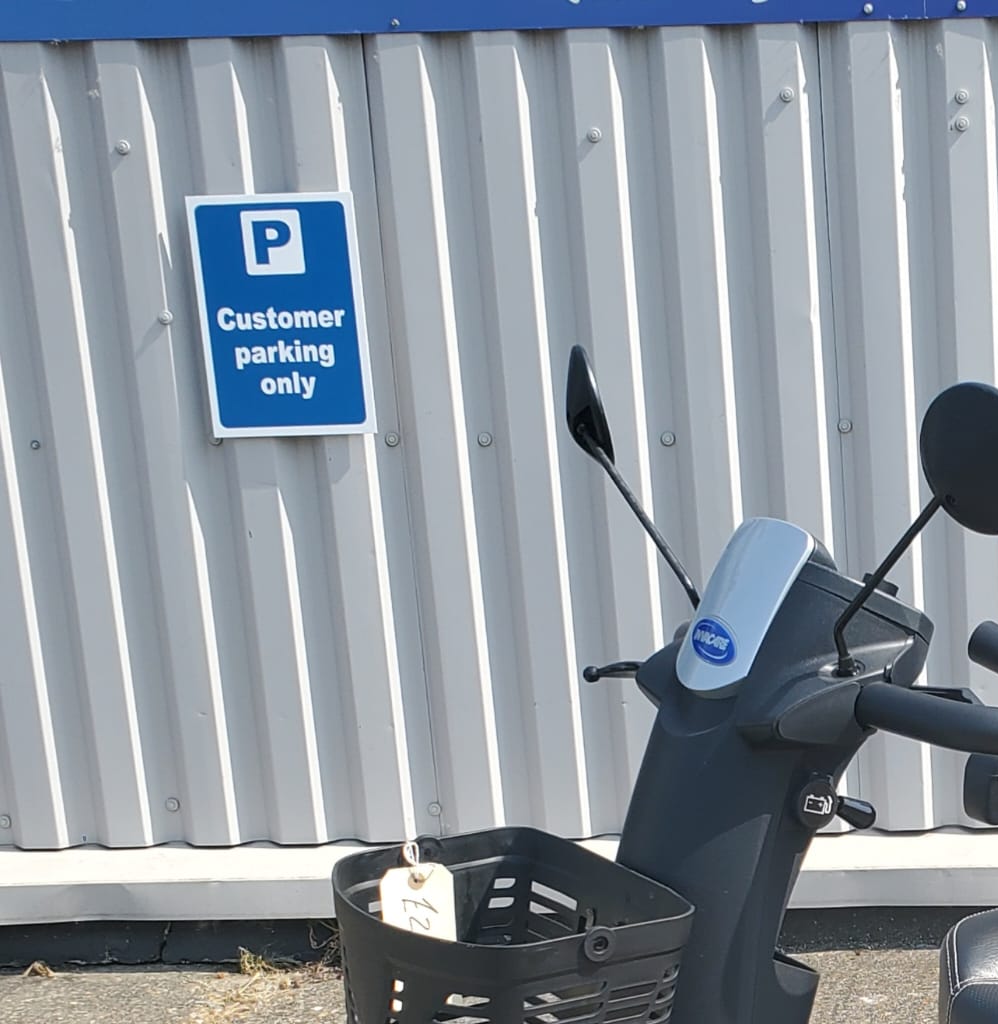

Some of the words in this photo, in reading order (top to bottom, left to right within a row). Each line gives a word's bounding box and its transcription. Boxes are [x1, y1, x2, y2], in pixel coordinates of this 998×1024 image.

[251, 219, 291, 265] P
[216, 306, 346, 331] Customer
[234, 340, 336, 370] parking
[260, 371, 317, 400] only
